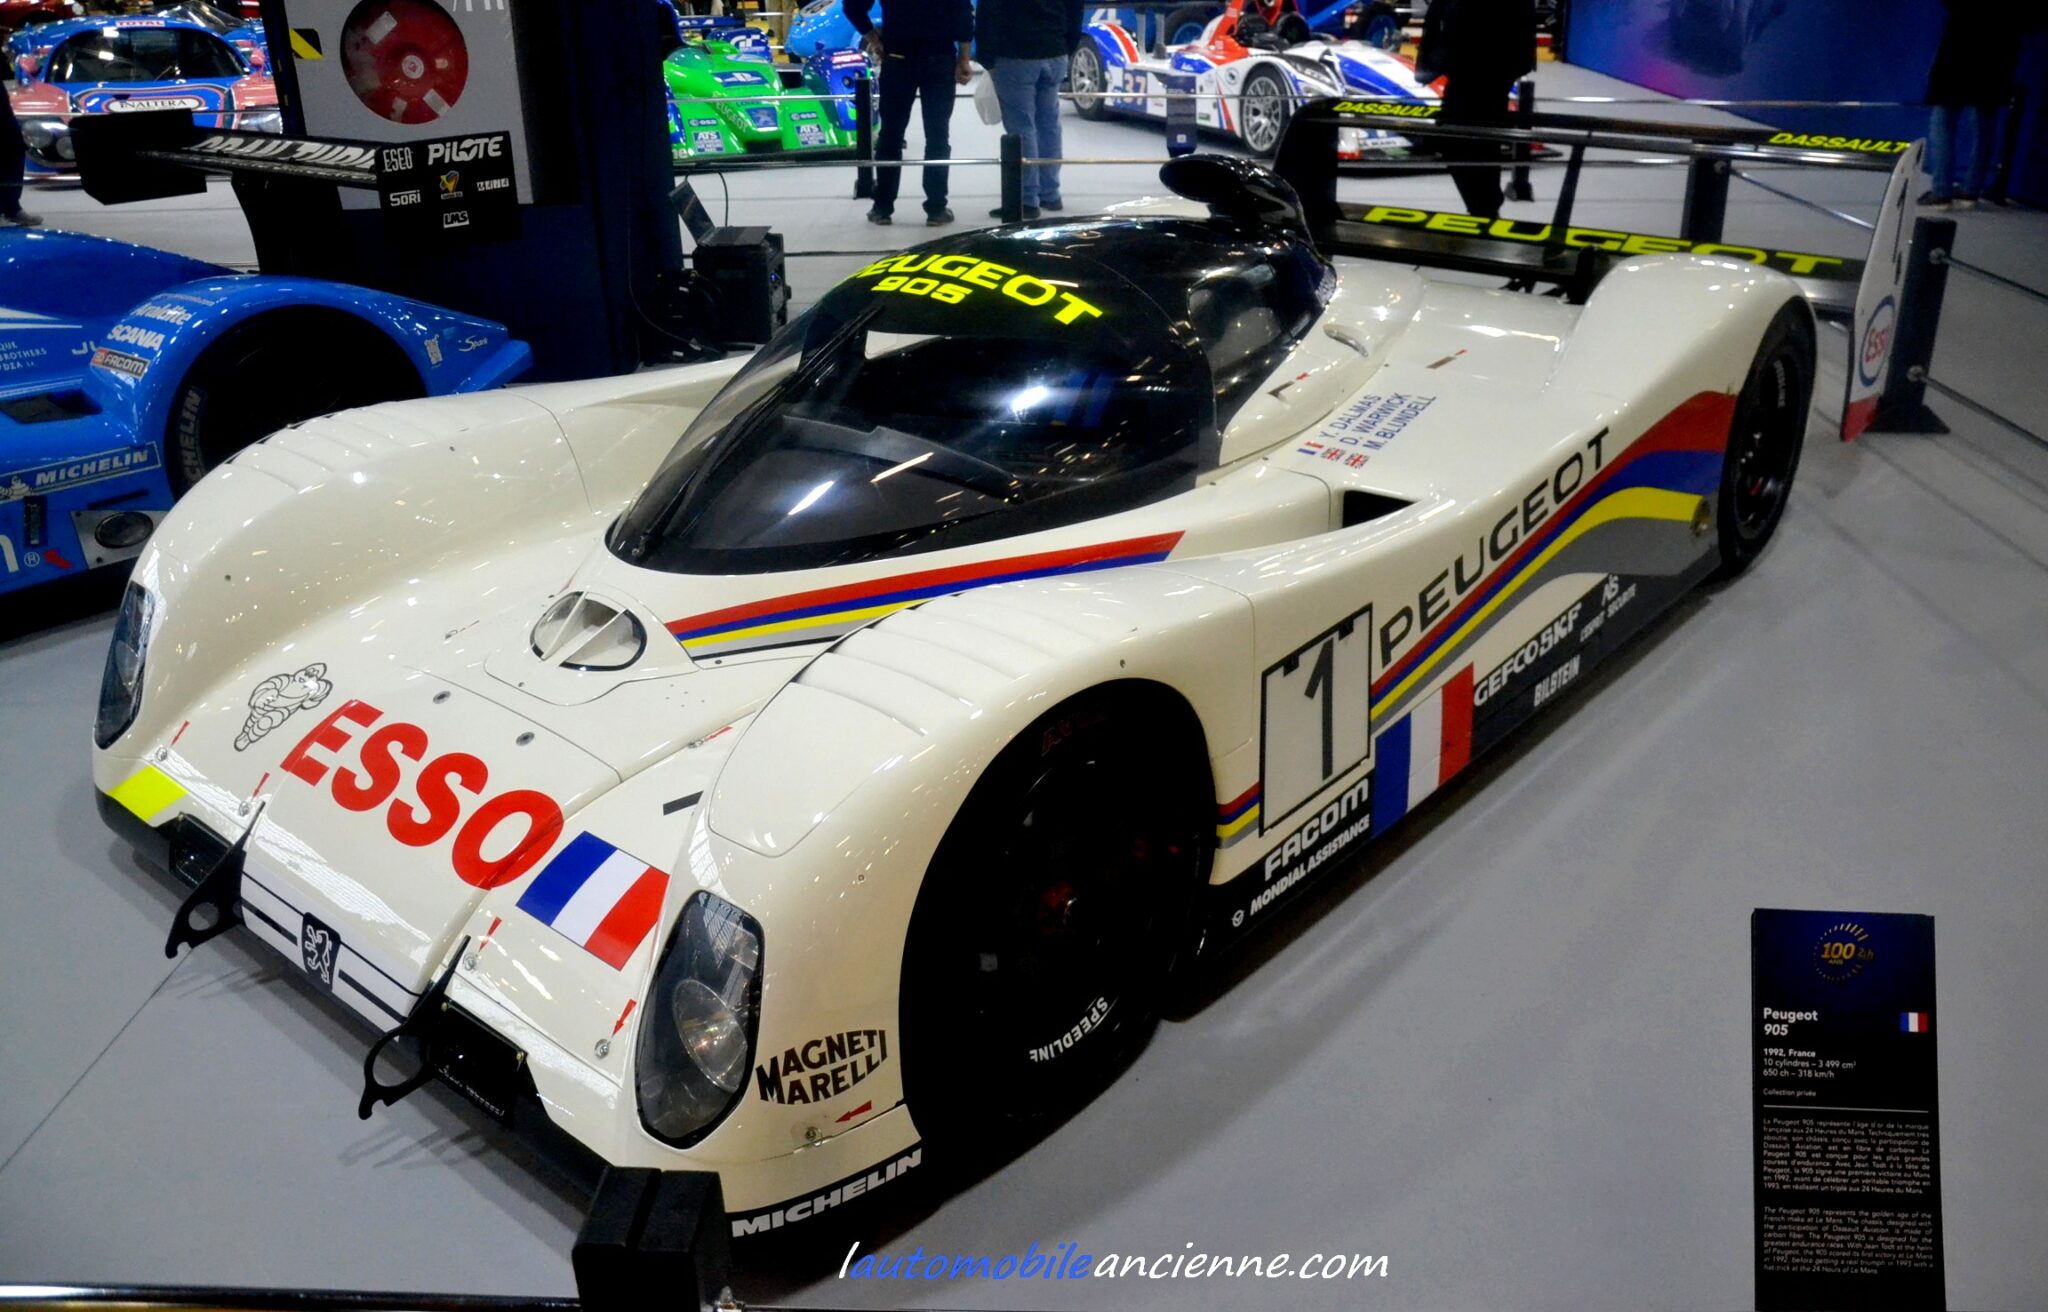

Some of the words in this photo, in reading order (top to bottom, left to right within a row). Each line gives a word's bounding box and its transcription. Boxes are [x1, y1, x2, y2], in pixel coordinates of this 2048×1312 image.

[120, 100, 187, 108] INALTERA
[1123, 72, 1147, 106] 37
[1332, 101, 1442, 118] DASSAULT
[1768, 132, 1911, 153] DASSAULT
[443, 211, 470, 228] LMS
[1363, 206, 1843, 274] PEUGEOT
[847, 253, 1103, 325] EUGEOT
[870, 276, 974, 304] 905
[106, 323, 166, 351] SCANIA
[103, 351, 145, 374] FACOM
[1329, 393, 1382, 430] DALMAS
[1351, 392, 1412, 434] WARWICK
[178, 388, 202, 482] CHELIN
[35, 449, 149, 486] MICHELIN
[1379, 426, 1610, 667] PEUGEOT
[1473, 639, 1540, 707] GEFCO
[1539, 602, 1583, 657] SKF
[1533, 654, 1581, 708] BILSTEIN
[1304, 635, 1334, 781] 1
[280, 699, 565, 890] ESSO
[1264, 777, 1369, 882] FACOM
[1250, 861, 1307, 917] MONDIAL
[1307, 813, 1371, 874] ASSISTANCE
[1820, 942, 1856, 960] 100
[1029, 996, 1109, 1063] SPEEDLINE
[1763, 1007, 1819, 1023] Peugeot
[1763, 1023, 1789, 1036] 905
[755, 1029, 888, 1090] MAGNETI
[1763, 1058, 1773, 1066] 10
[1775, 1058, 1810, 1069] cylindres
[1825, 1060, 1840, 1068] 499
[1788, 1048, 1816, 1058] France
[755, 1050, 888, 1105] MARELLI
[1763, 1068, 1778, 1077] 650
[1779, 1069, 1790, 1077] ch
[1797, 1070, 1813, 1078] 318
[1814, 1070, 1835, 1079] km/h
[1763, 1088, 1796, 1096] Collection
[732, 1147, 923, 1238] MICHELIN
